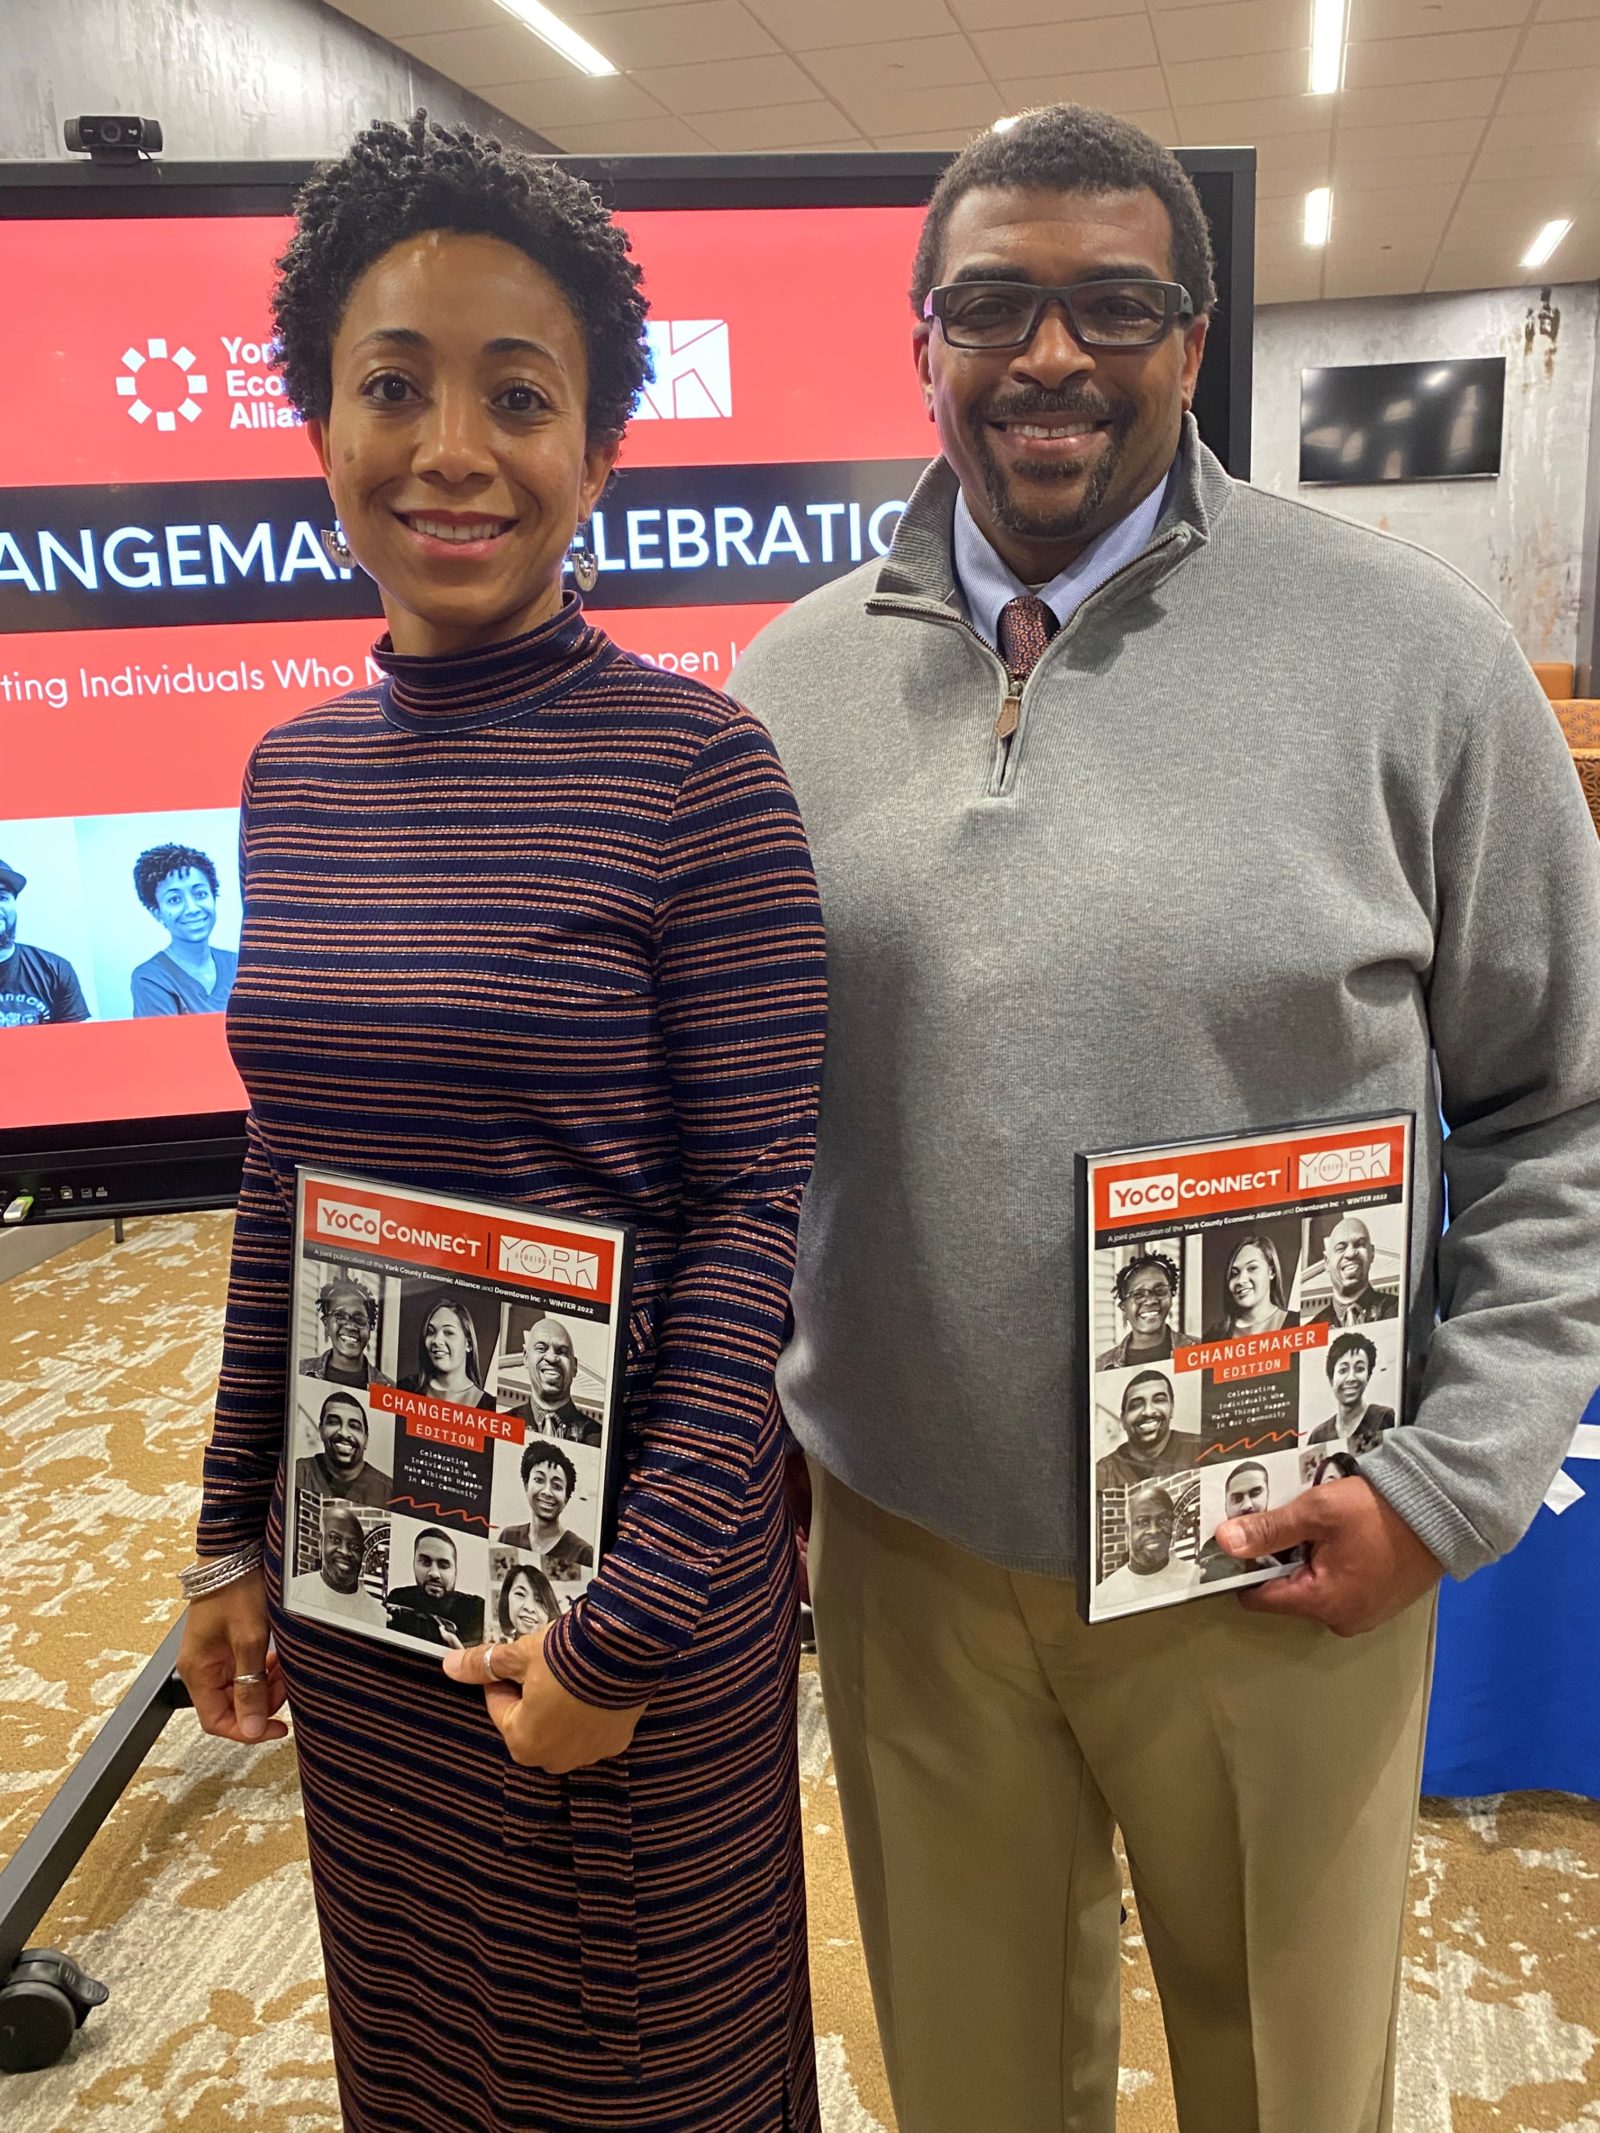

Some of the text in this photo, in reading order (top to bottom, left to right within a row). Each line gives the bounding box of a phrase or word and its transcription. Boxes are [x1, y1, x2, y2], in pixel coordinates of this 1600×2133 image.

[221, 336, 283, 364] Yor
[226, 369, 286, 397] Eco
[80, 661, 265, 698] Individuals
[271, 657, 355, 691] Who
[1298, 1142, 1391, 1190] YORK
[1184, 1222, 1198, 1230] York
[1200, 1219, 1223, 1228] County
[1224, 1214, 1255, 1224] Economic
[1256, 1210, 1282, 1220] Alliance
[1295, 1202, 1328, 1214] Downtown
[1346, 1195, 1372, 1205] WINTER
[498, 1234, 599, 1291] YORK
[384, 1263, 400, 1272] York
[400, 1267, 422, 1278] County
[423, 1272, 453, 1284] Economic
[454, 1278, 480, 1290] Alliance
[494, 1286, 530, 1300] Downtown
[530, 1294, 540, 1302] Inc
[549, 1298, 576, 1310] WINTER
[577, 1306, 594, 1314] 2022
[1187, 1330, 1316, 1366] CHANGEMAKER
[1223, 1359, 1281, 1379] EDITION
[382, 1393, 512, 1437] CHANGEMAKER
[416, 1424, 475, 1447] EDITION
[404, 1464, 422, 1474] Make
[426, 1468, 452, 1482] Things
[411, 1456, 477, 1478] Individuals Who
[420, 1450, 469, 1468] Celebrating
[421, 1479, 434, 1487] Our
[438, 1483, 478, 1500] Community
